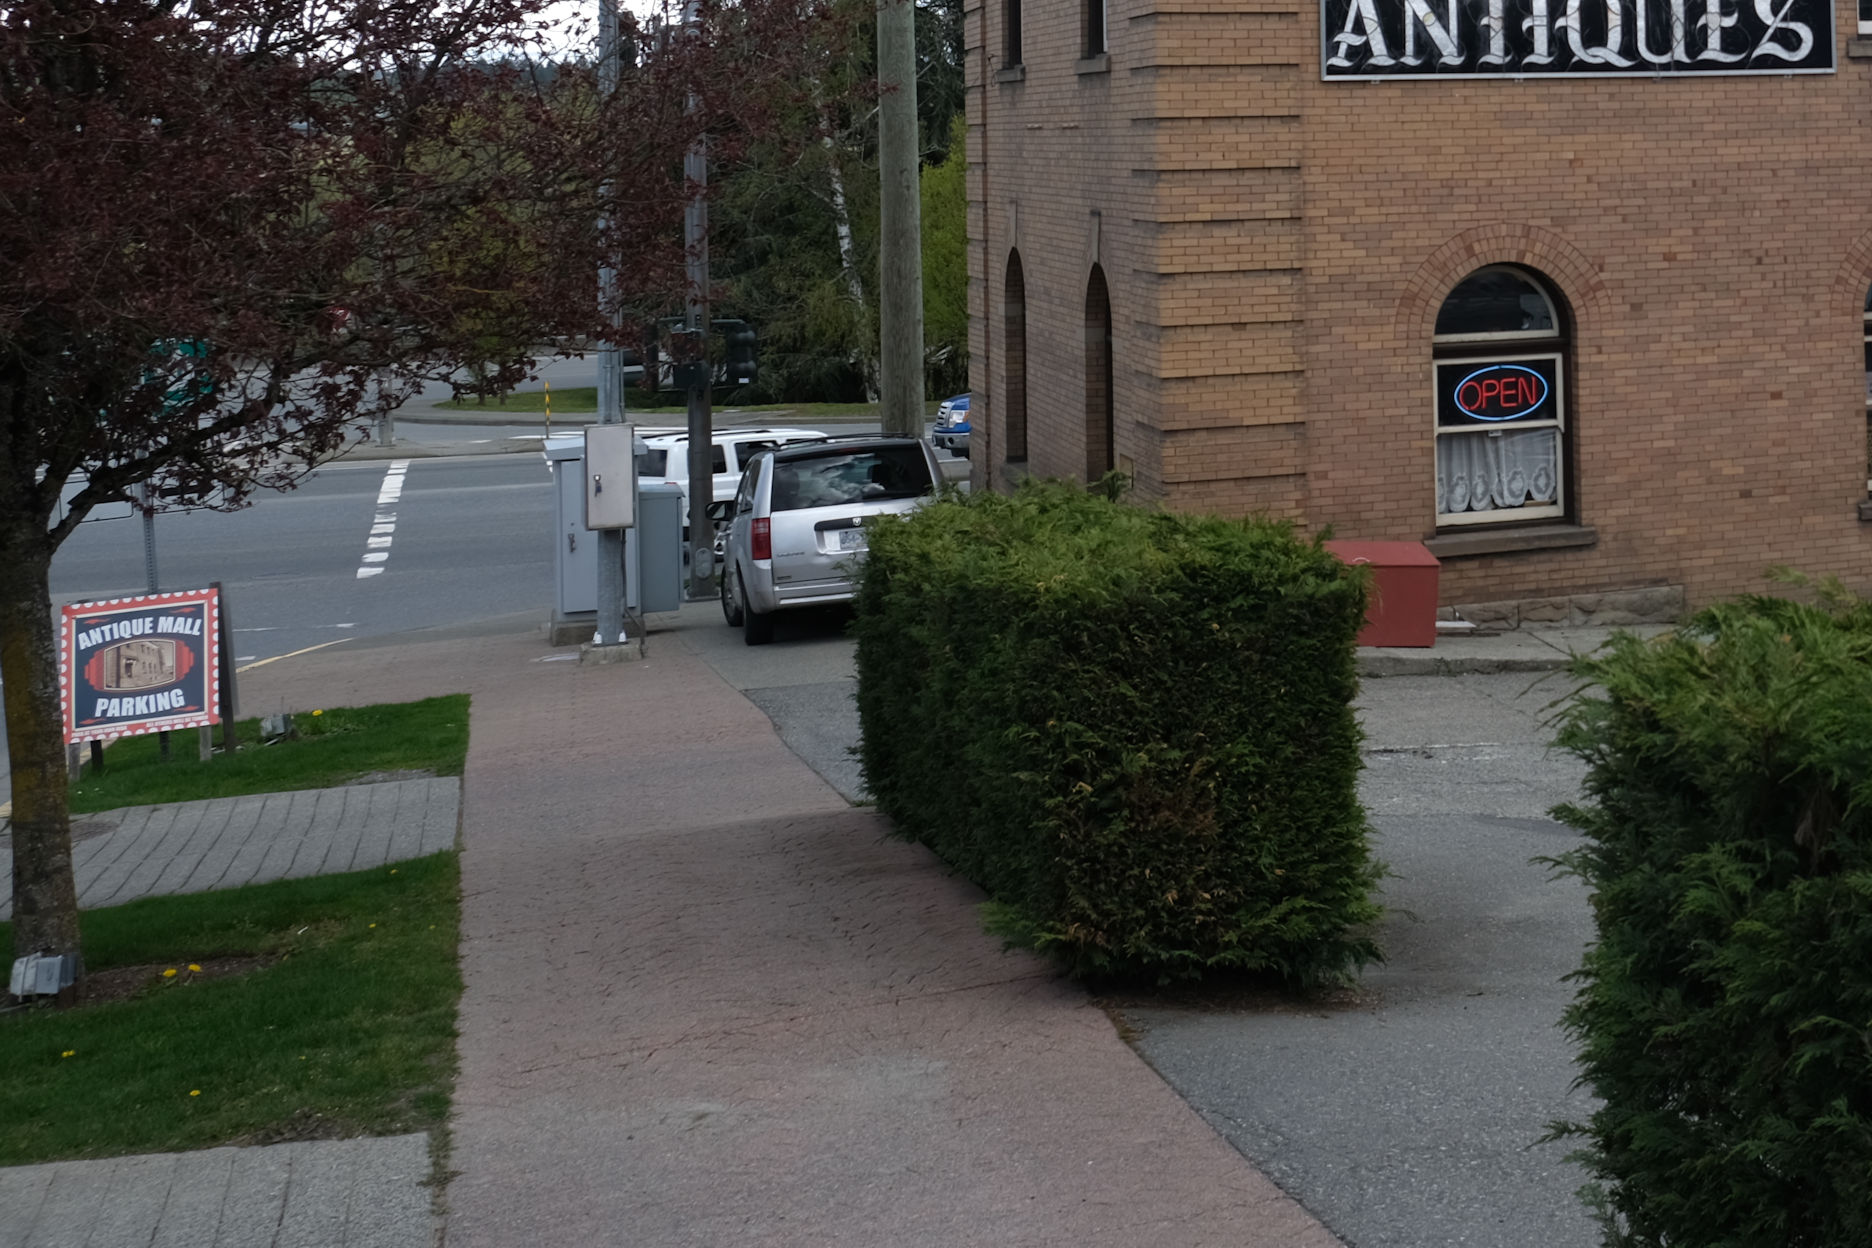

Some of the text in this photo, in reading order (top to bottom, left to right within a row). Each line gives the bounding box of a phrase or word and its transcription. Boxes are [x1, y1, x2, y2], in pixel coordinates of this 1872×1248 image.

[1459, 376, 1537, 411] OPEN
[78, 616, 202, 650] ANTIQUE MALL
[95, 688, 185, 718] PARKING
